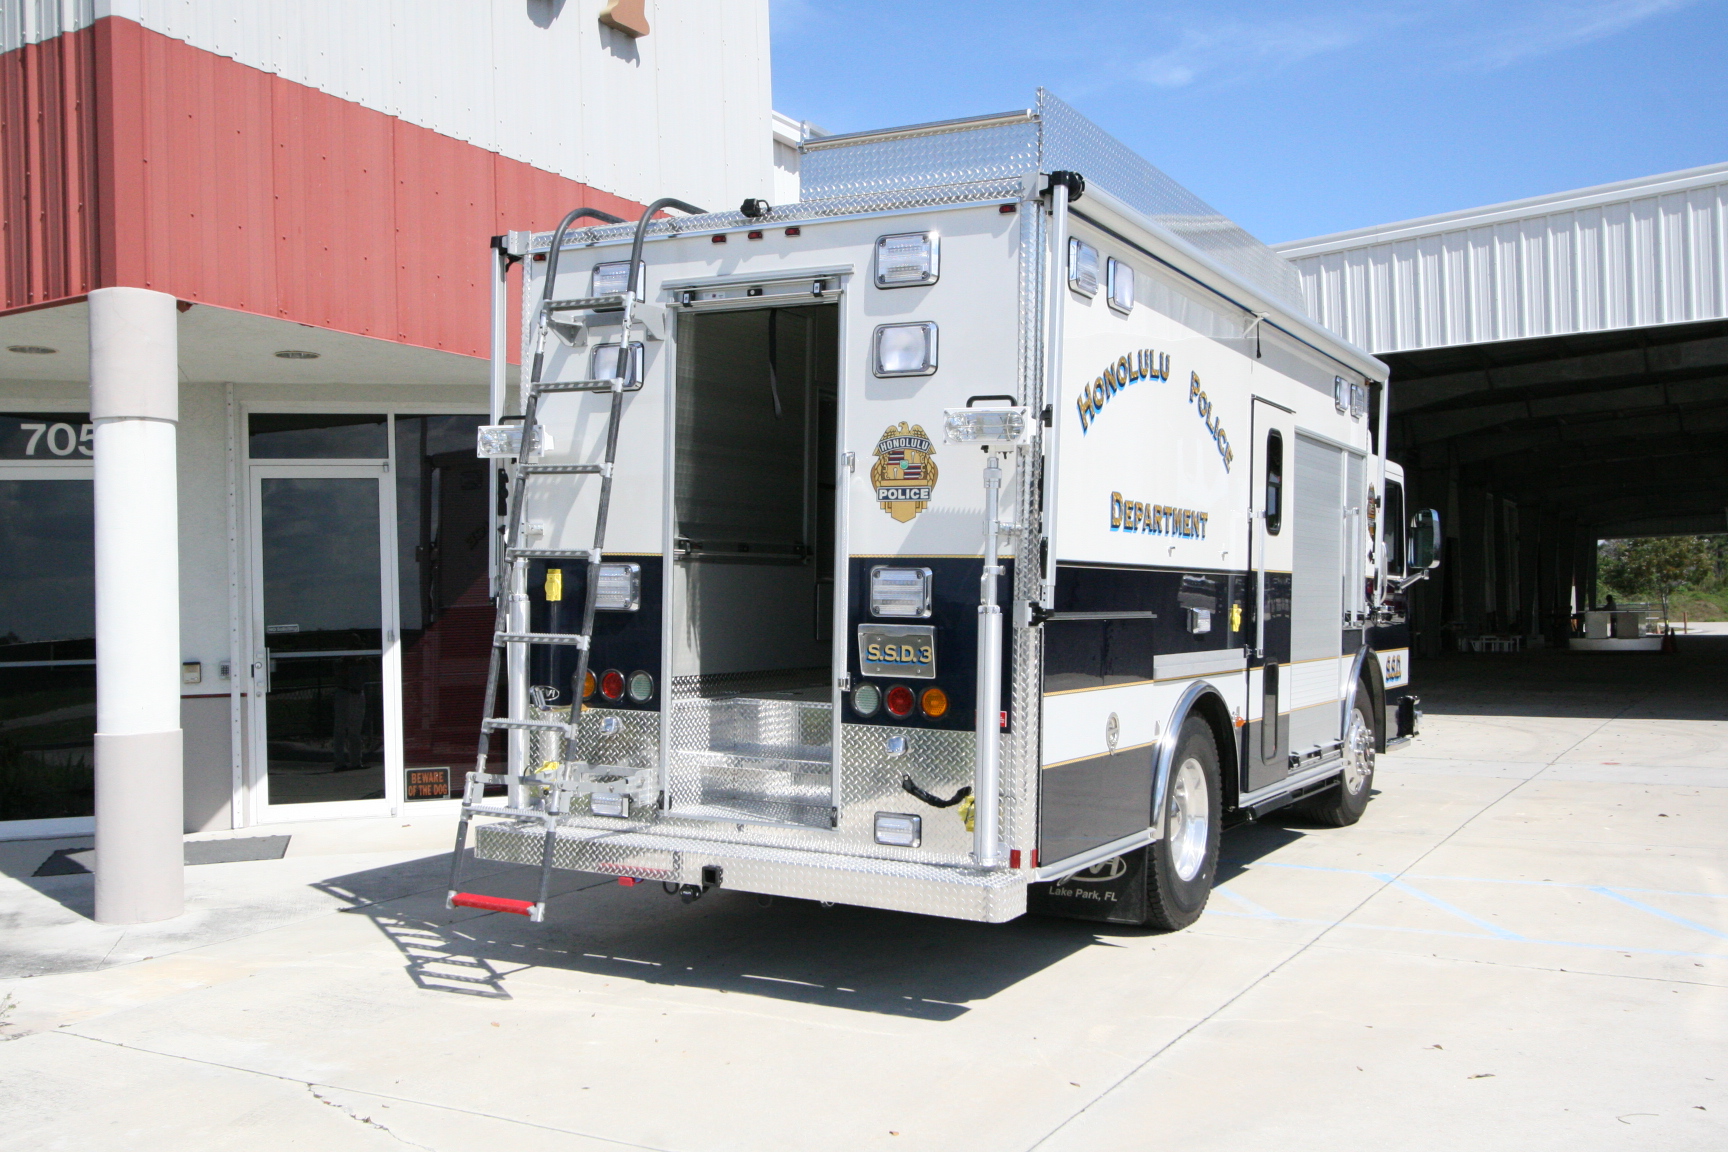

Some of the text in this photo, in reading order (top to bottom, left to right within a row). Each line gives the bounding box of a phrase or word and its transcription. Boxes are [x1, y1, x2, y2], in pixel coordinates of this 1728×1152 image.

[1076, 348, 1235, 474] HONOLULU POLICE
[20, 422, 95, 456] 705
[879, 437, 929, 453] HONOLULU
[878, 488, 930, 500] POLICE
[1110, 490, 1209, 540] DEPARTMENT
[411, 771, 444, 784] BEWARE
[408, 783, 448, 797] OF THE DOG
[1048, 885, 1118, 902] Lake Park, FL
